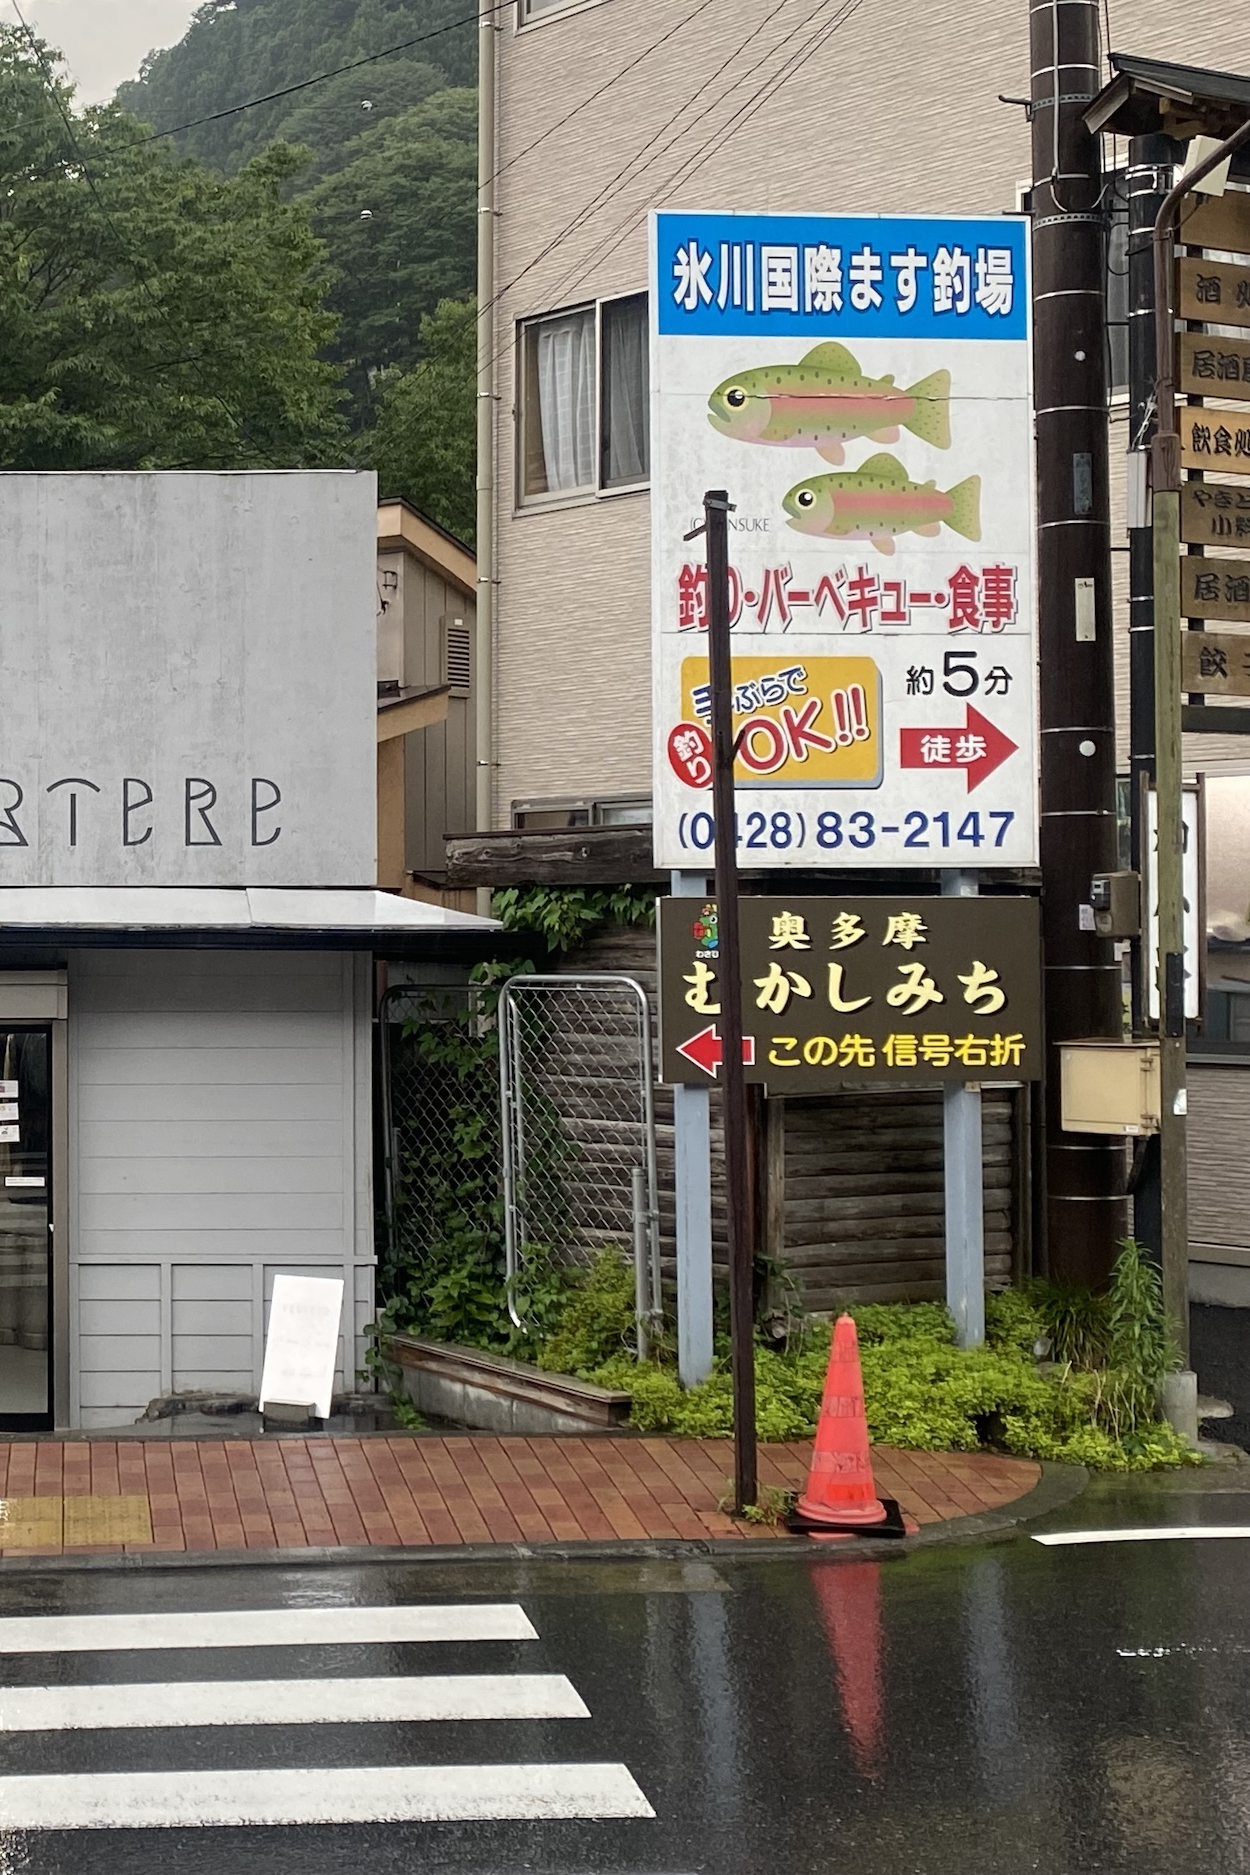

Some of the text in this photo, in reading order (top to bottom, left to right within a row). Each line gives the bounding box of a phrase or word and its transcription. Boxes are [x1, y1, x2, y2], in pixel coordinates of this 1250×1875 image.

[672, 241, 1014, 315] 氷川国際ます釣場
[906, 651, 1013, 697] 約5分
[737, 686, 868, 771] OK!!
[920, 734, 987, 763] 徒歩
[673, 730, 712, 784] 釣り
[678, 811, 1015, 849] (028)83-2147
[768, 911, 928, 950] 奥多摩
[682, 960, 1007, 1015] むかしみち
